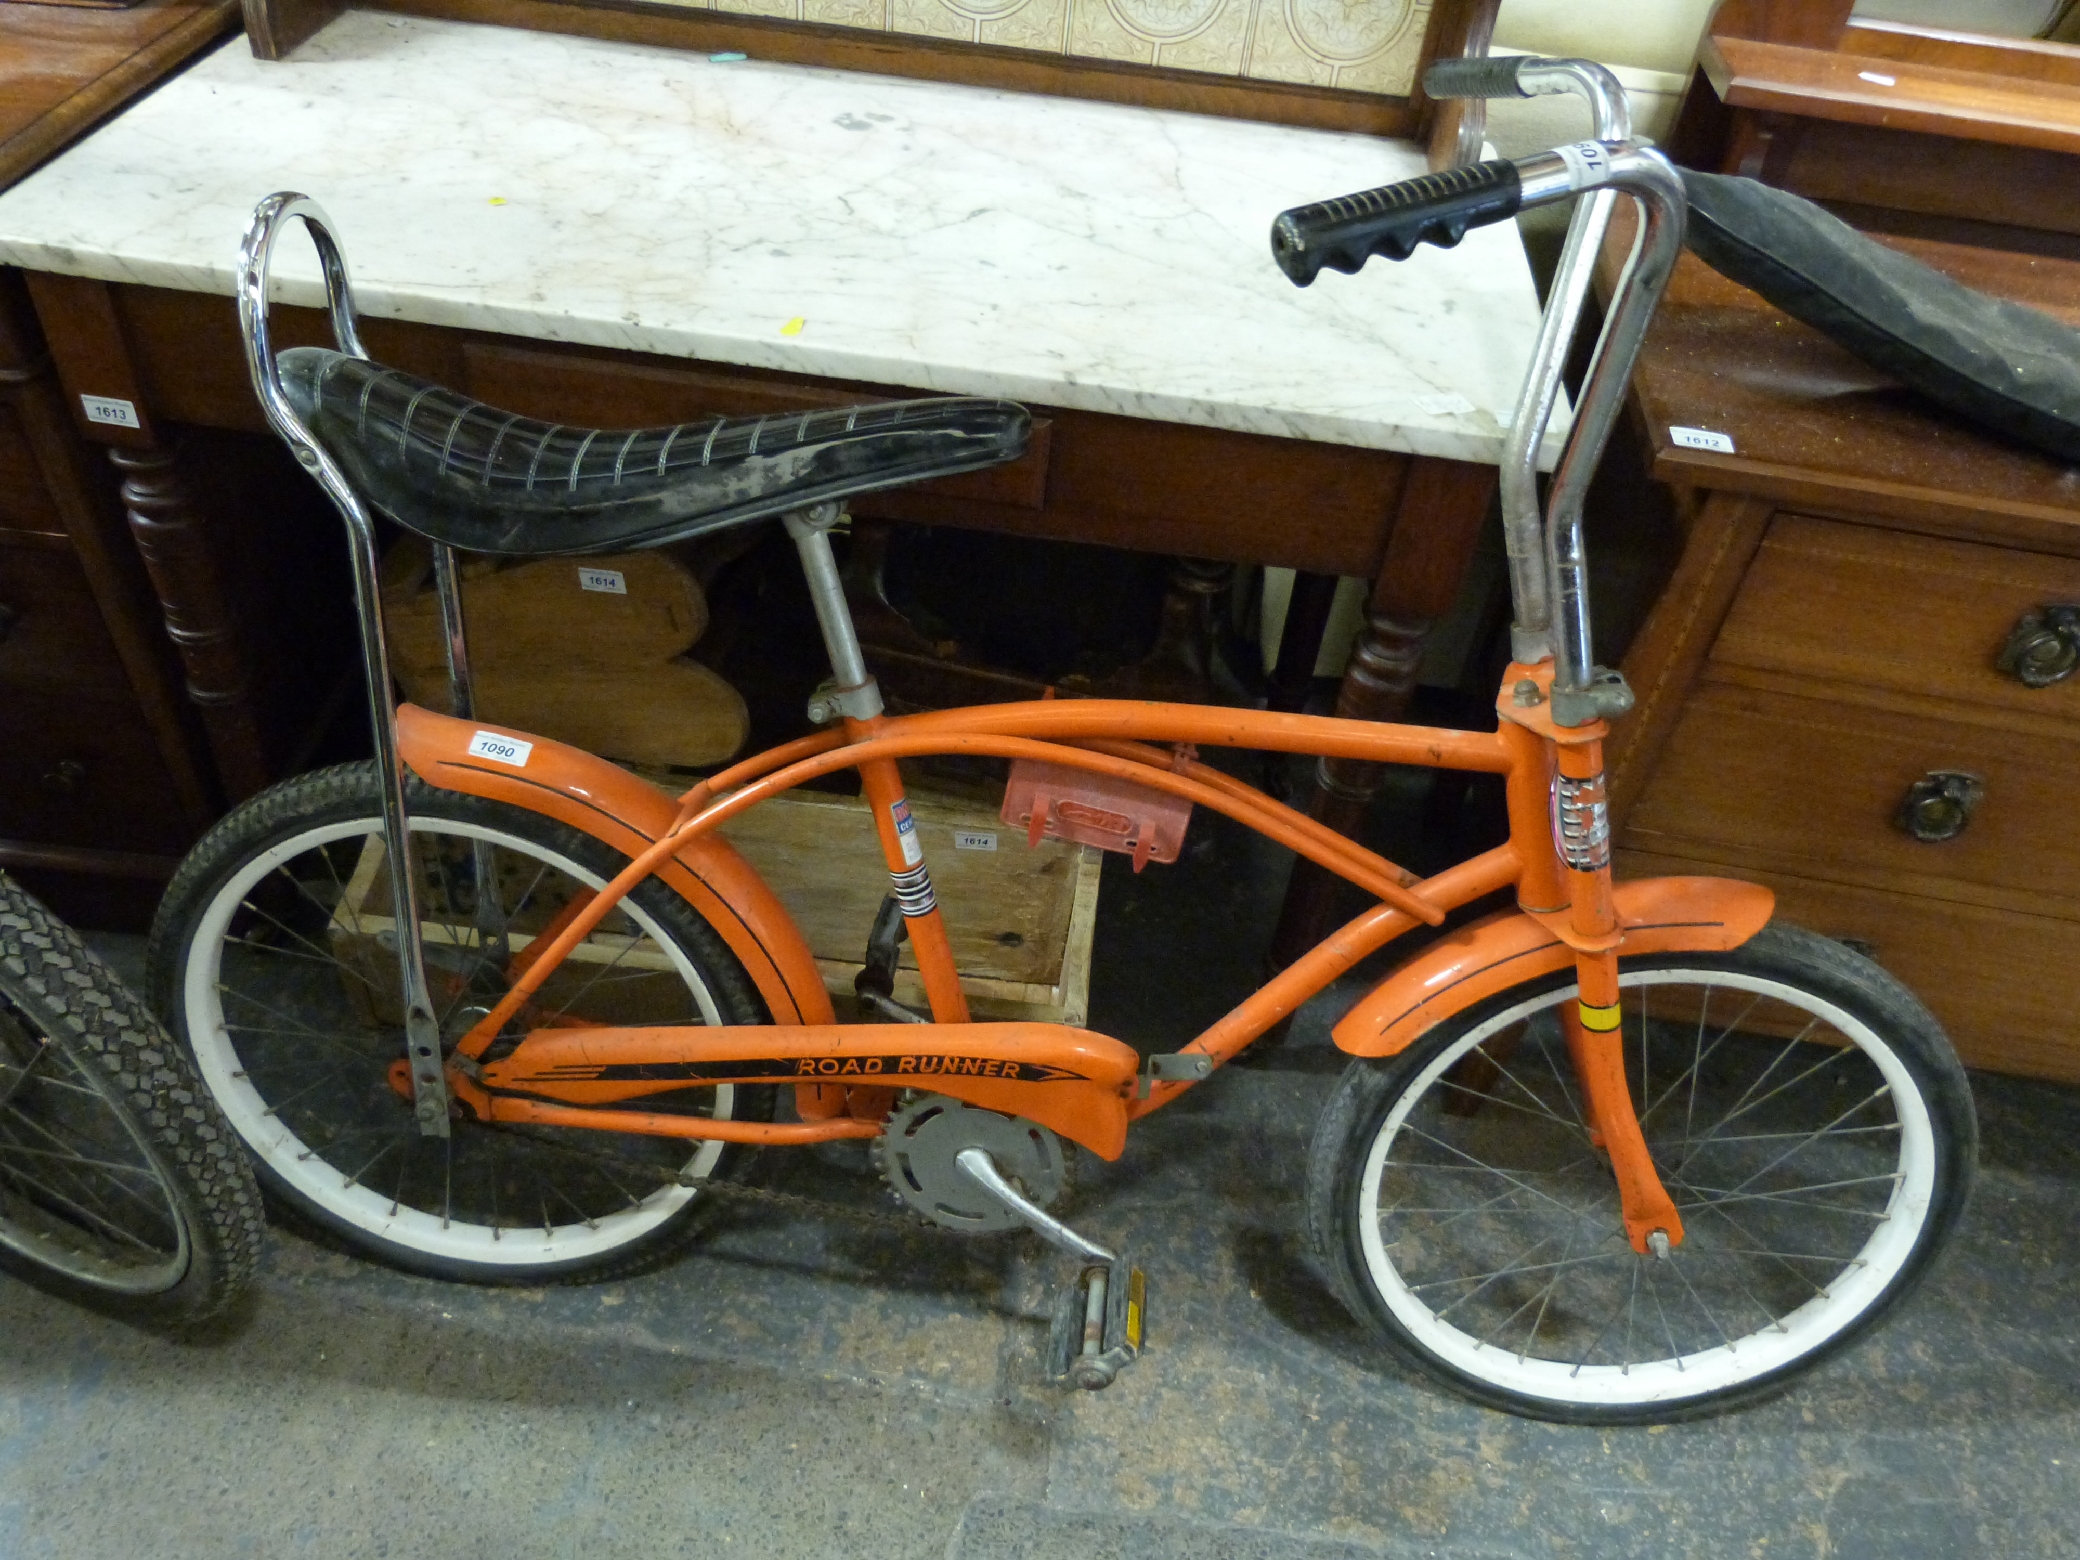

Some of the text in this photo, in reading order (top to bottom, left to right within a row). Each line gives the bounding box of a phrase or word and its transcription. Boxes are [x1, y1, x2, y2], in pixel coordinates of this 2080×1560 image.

[95, 406, 126, 420] 1613
[1684, 436, 1720, 447] 1612
[589, 576, 616, 588] 1614
[480, 741, 515, 757] 1090
[964, 837, 988, 846] 1614
[797, 1056, 1020, 1078] ROAD RUNNER
